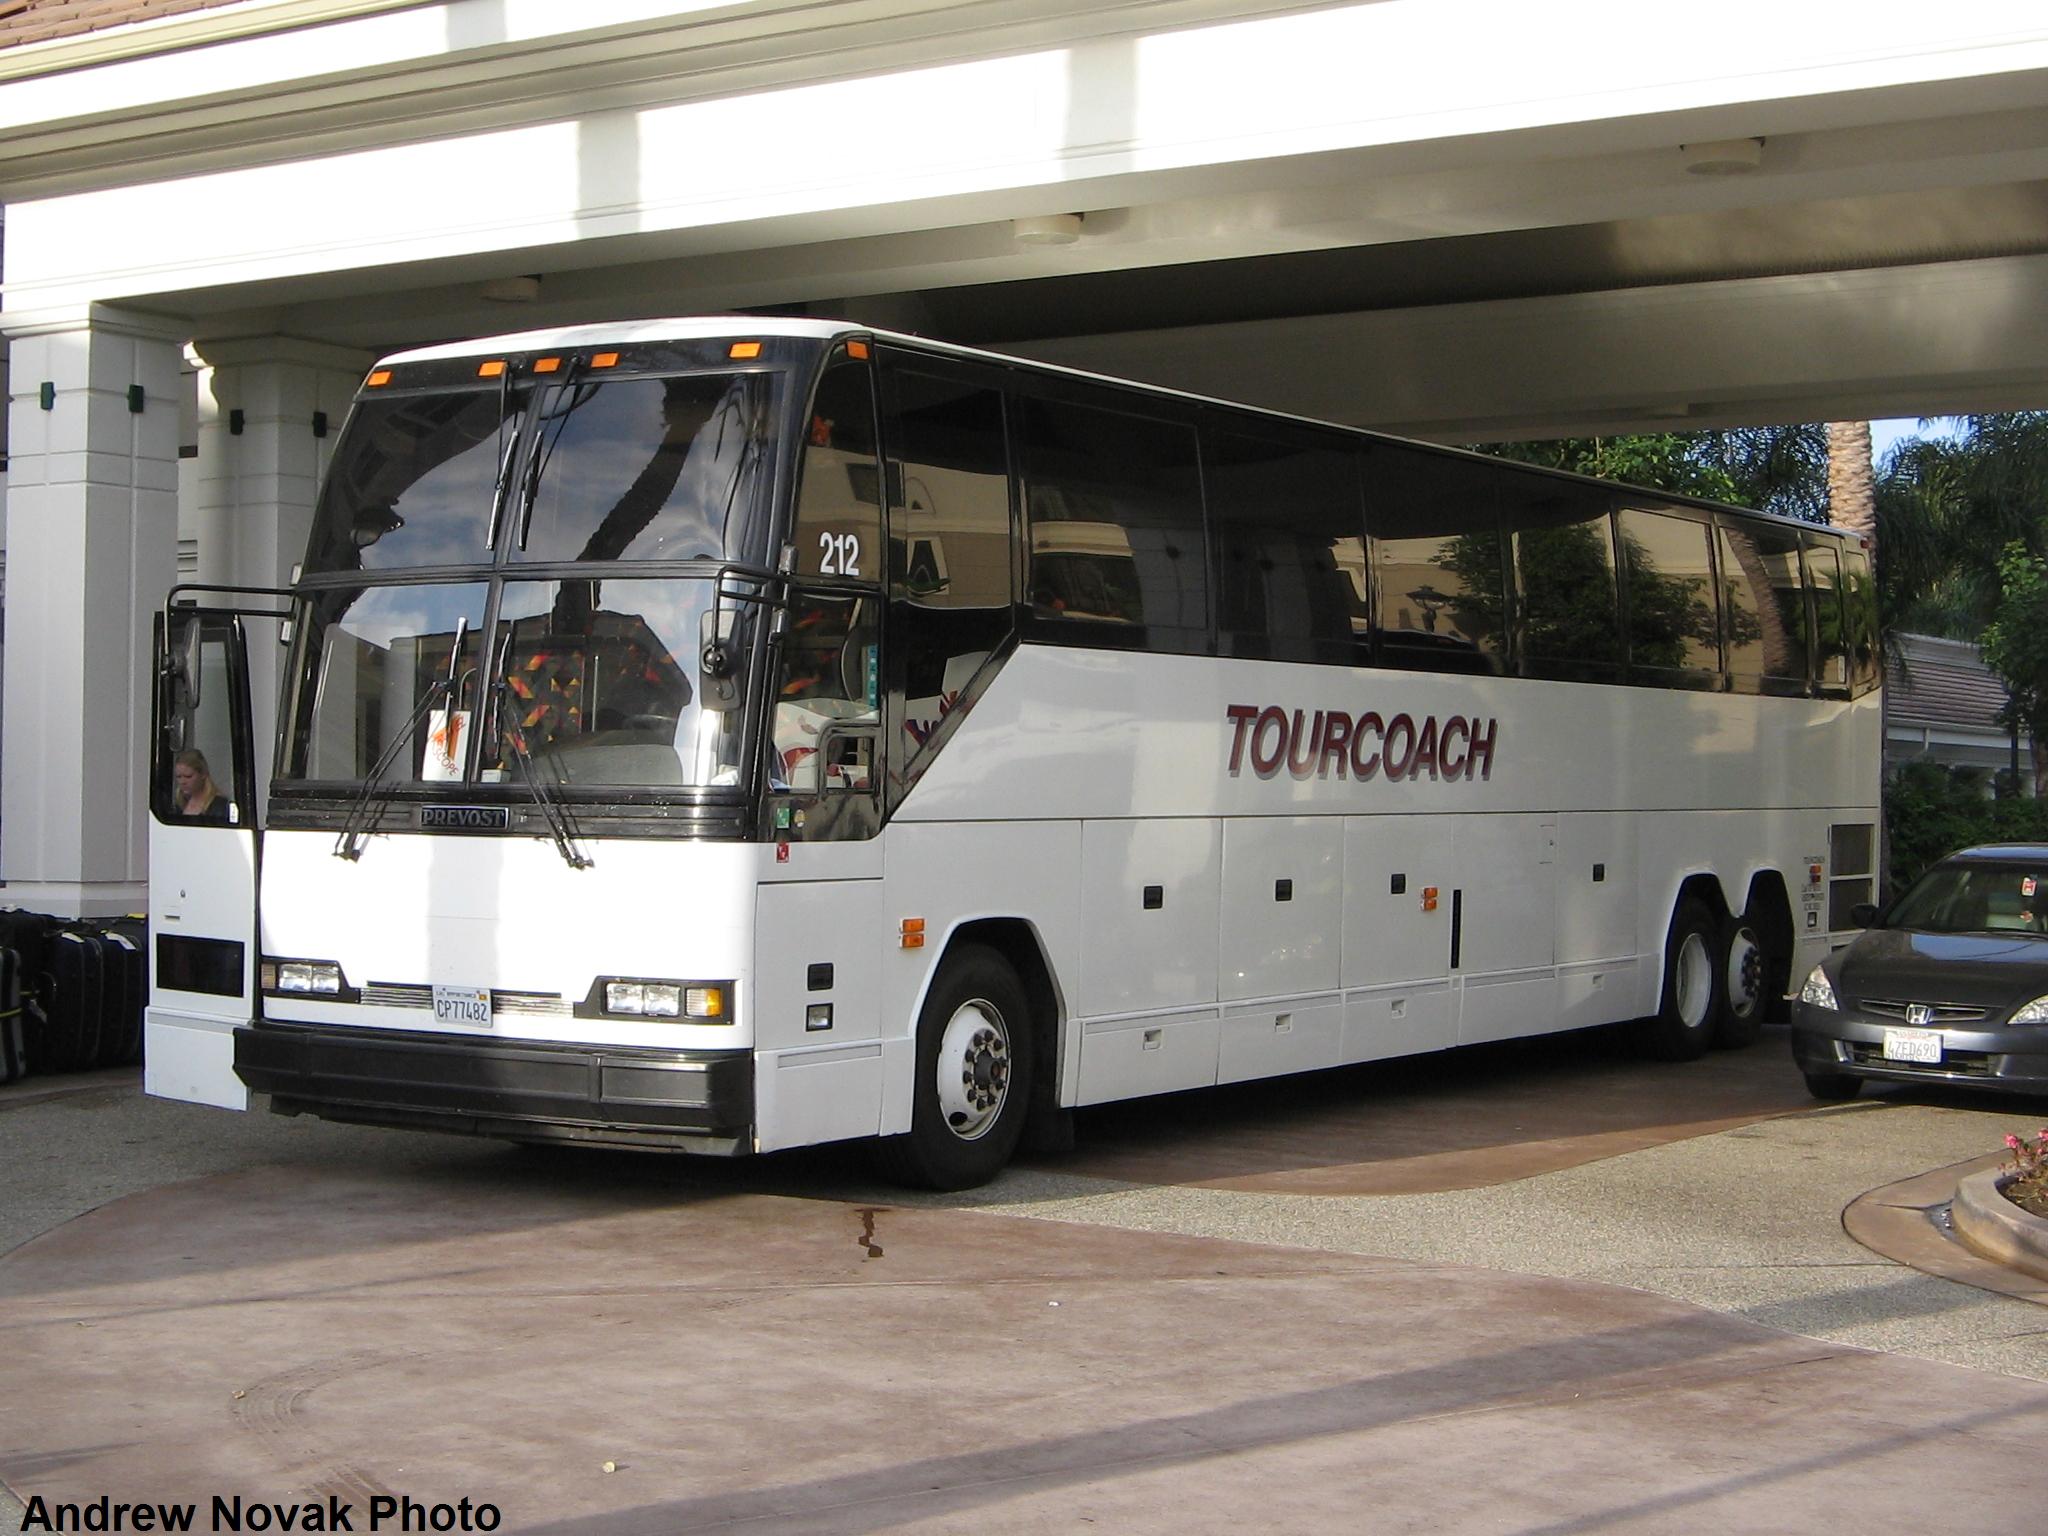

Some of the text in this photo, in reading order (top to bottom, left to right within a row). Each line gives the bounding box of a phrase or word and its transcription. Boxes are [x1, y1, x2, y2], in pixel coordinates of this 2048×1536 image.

[819, 531, 860, 576] 212
[1226, 703, 1498, 783] TOURCOACH
[422, 809, 504, 826] PREVOST
[437, 1000, 487, 1021] CP77482
